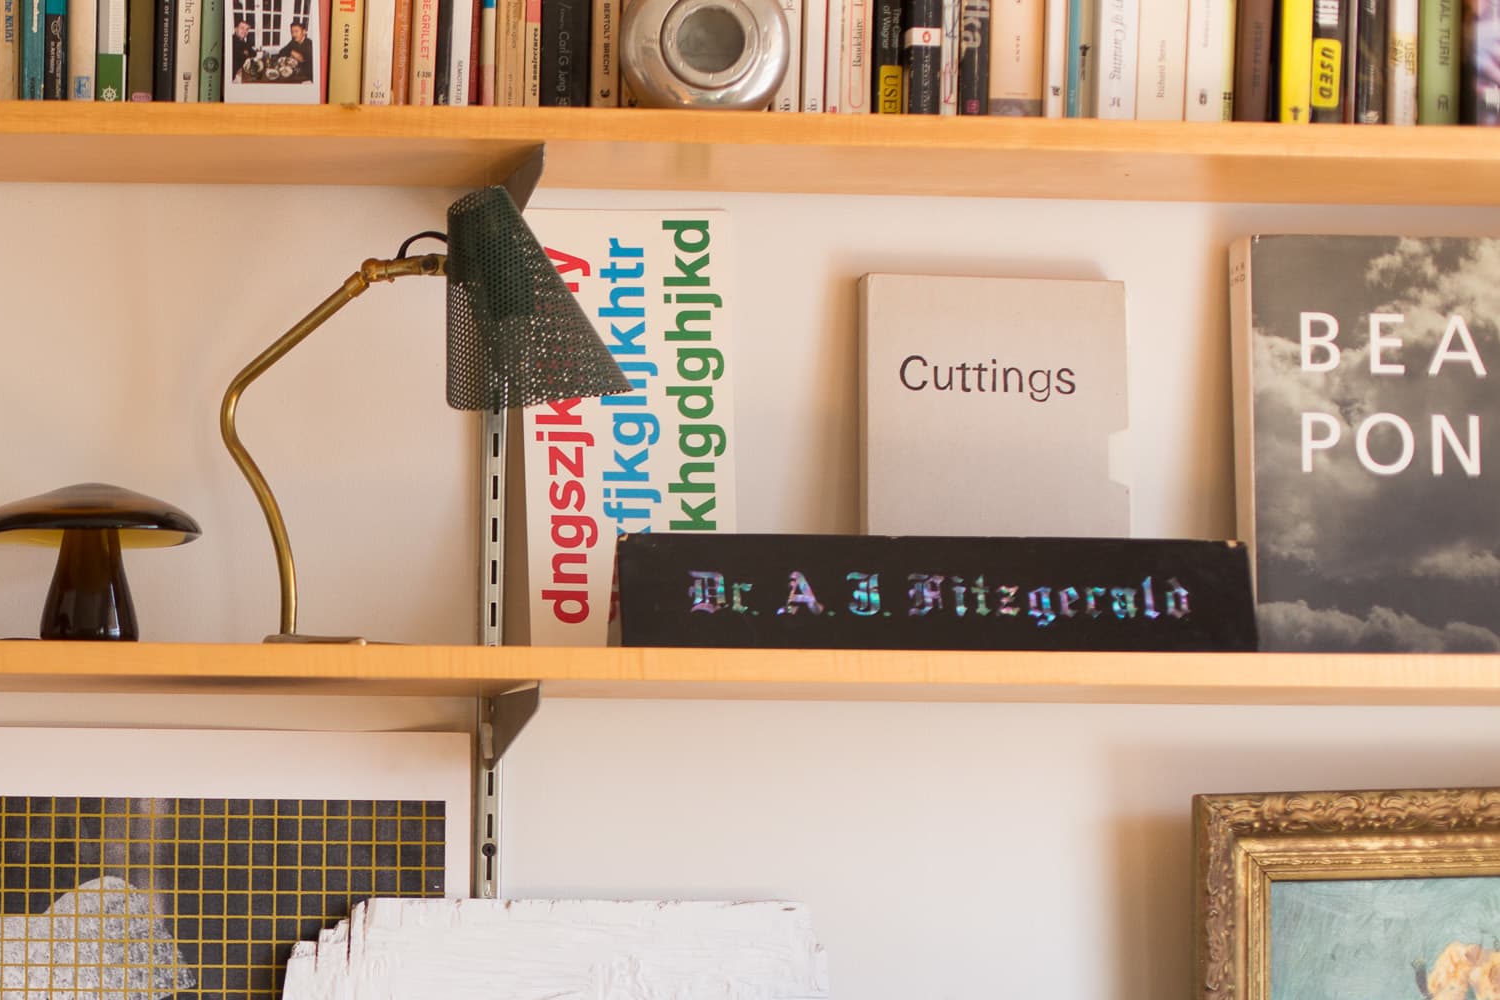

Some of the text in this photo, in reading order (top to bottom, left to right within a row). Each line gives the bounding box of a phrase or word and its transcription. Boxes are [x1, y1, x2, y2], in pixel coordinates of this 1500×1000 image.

[183, 17, 195, 45] Trees
[558, 31, 571, 53] Carl
[601, 3, 611, 76] BERTOLT BRECHT
[851, 19, 866, 68] Baudelaire
[882, 17, 892, 49] Wagner
[1437, 29, 1452, 67] TURN
[555, 70, 571, 92] Jung
[1318, 46, 1335, 99] USED
[899, 354, 1077, 402] Cuttings
[907, 573, 1192, 628] Fitzgerald
